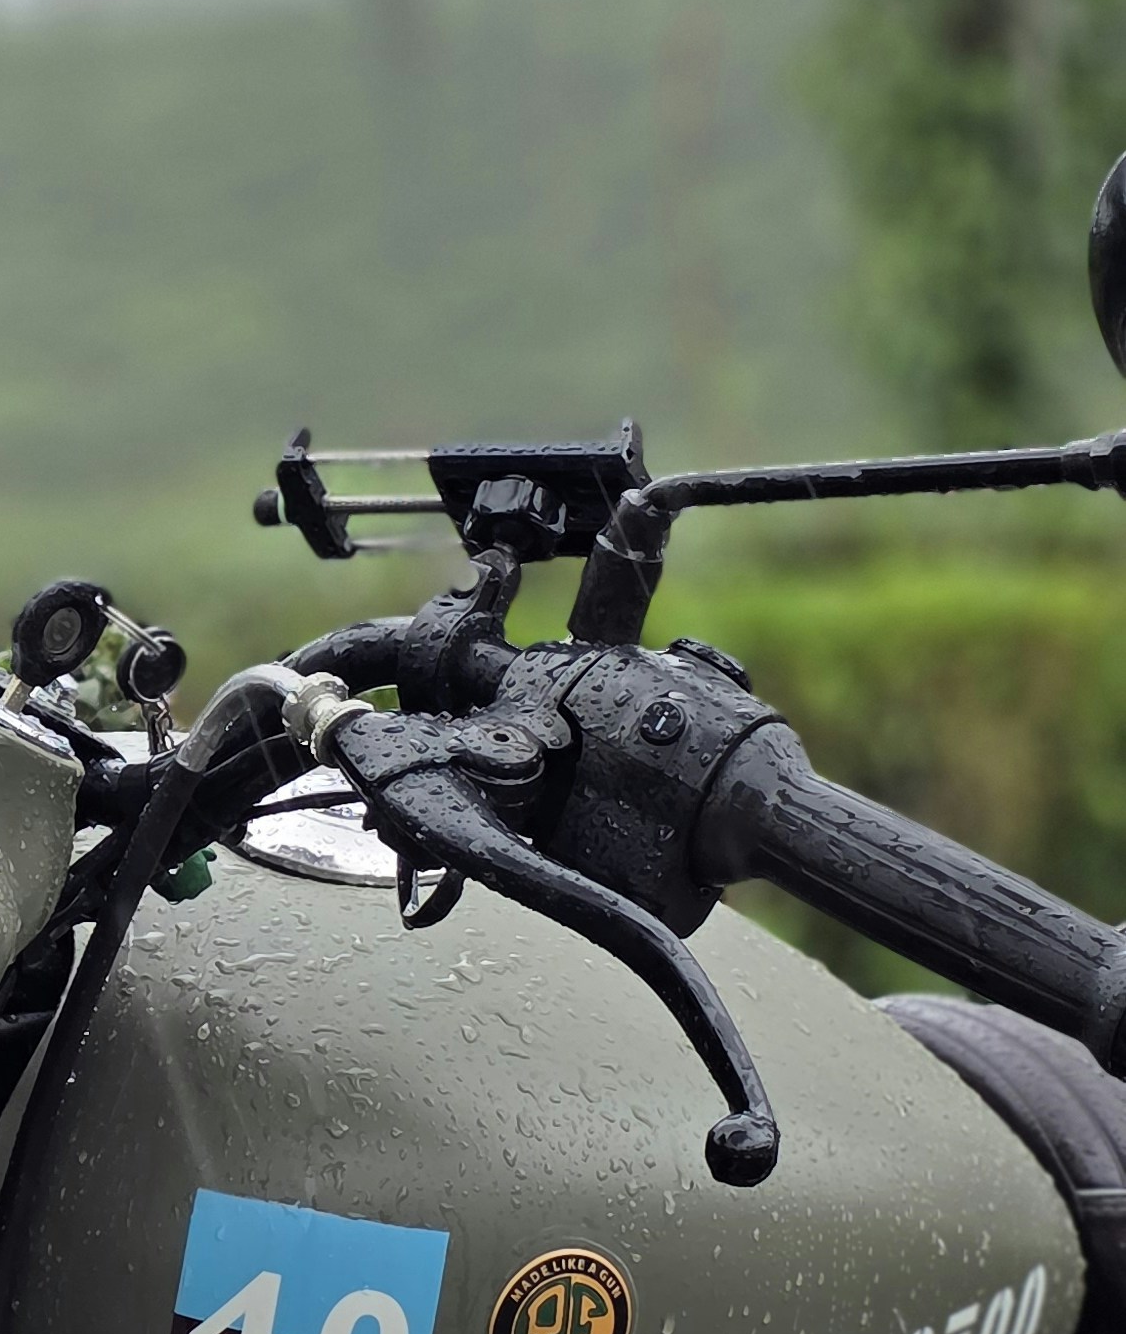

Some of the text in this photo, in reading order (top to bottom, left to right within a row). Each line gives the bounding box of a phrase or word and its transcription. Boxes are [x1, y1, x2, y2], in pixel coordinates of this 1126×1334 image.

[510, 1257, 623, 1303] MADE LIKE A GUN
